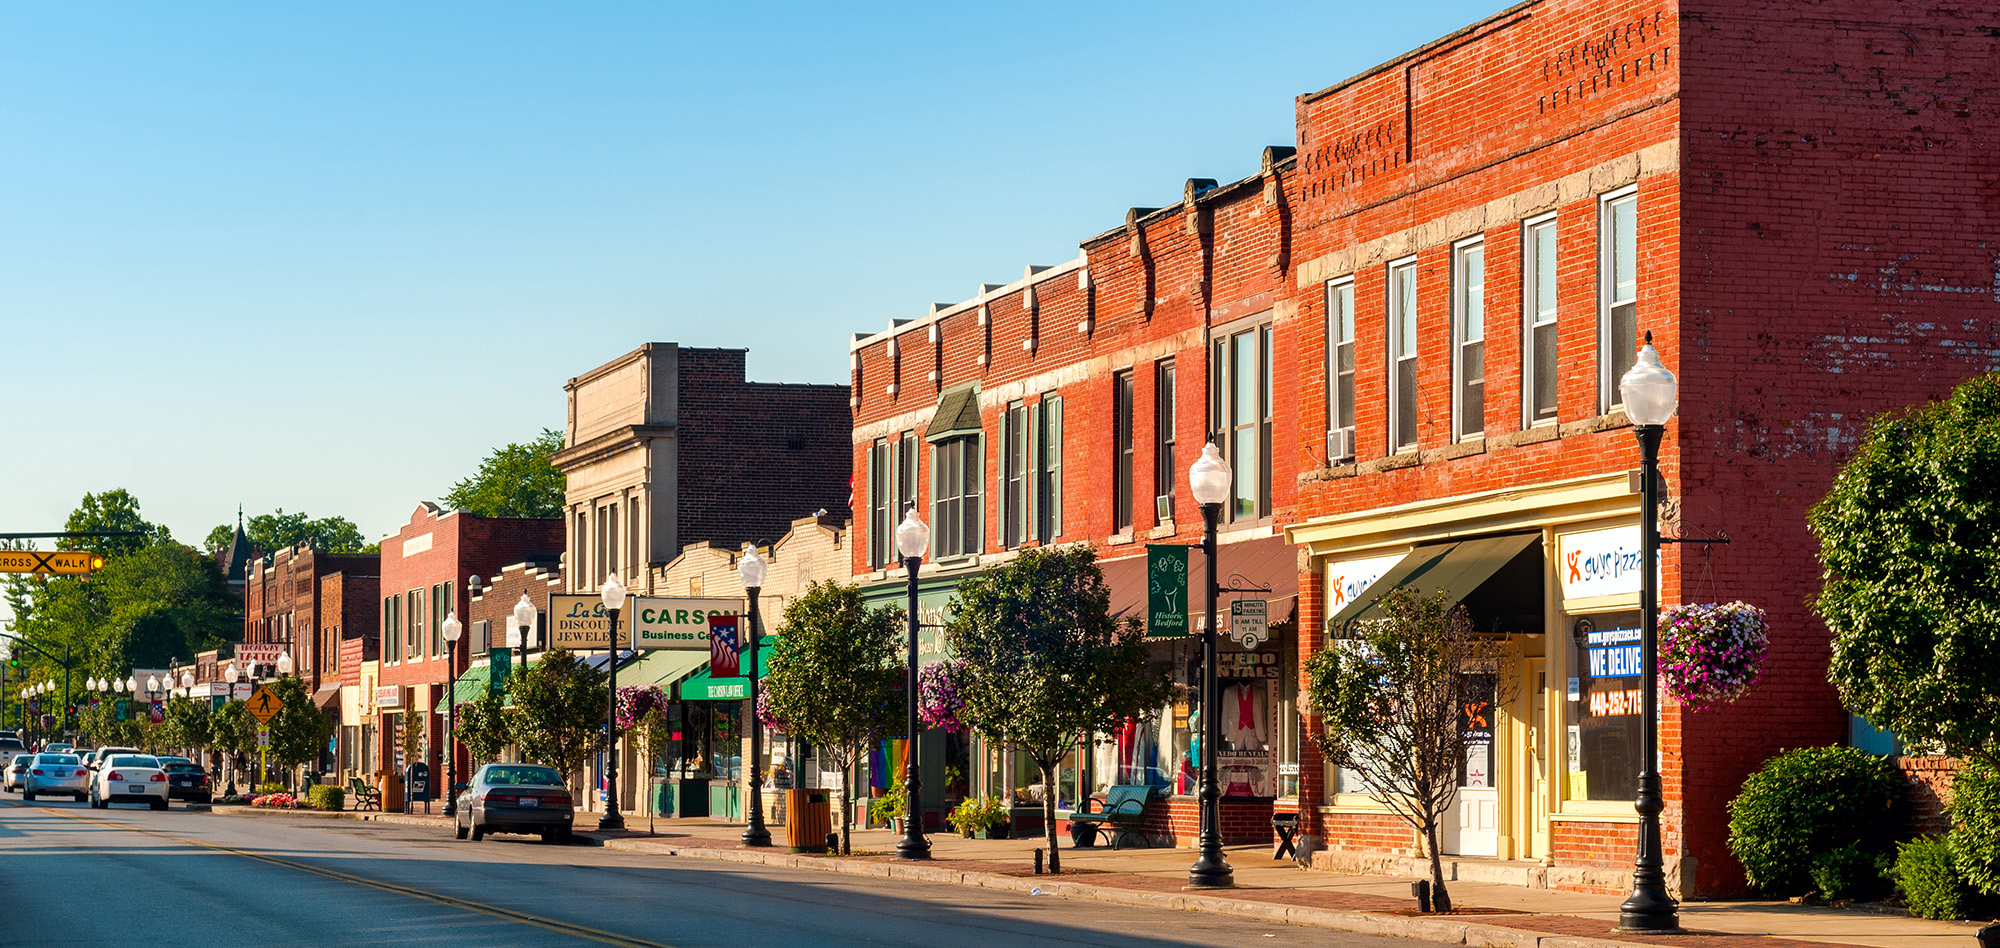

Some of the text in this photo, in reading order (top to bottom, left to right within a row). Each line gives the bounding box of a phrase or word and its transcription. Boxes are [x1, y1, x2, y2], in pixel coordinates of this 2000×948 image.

[0, 558, 85, 568] ROSS WALK
[1585, 552, 1611, 581] guys
[566, 602, 590, 618] La
[1232, 602, 1242, 613] 15
[1154, 611, 1183, 619] Historic
[1154, 619, 1183, 628] Bedford
[1196, 614, 1224, 630] ANES
[557, 631, 627, 642] JEWELES
[642, 631, 694, 640] Business
[1216, 653, 1276, 664] XEDO
[1589, 648, 1606, 676] WE
[1216, 666, 1279, 678] NTALS
